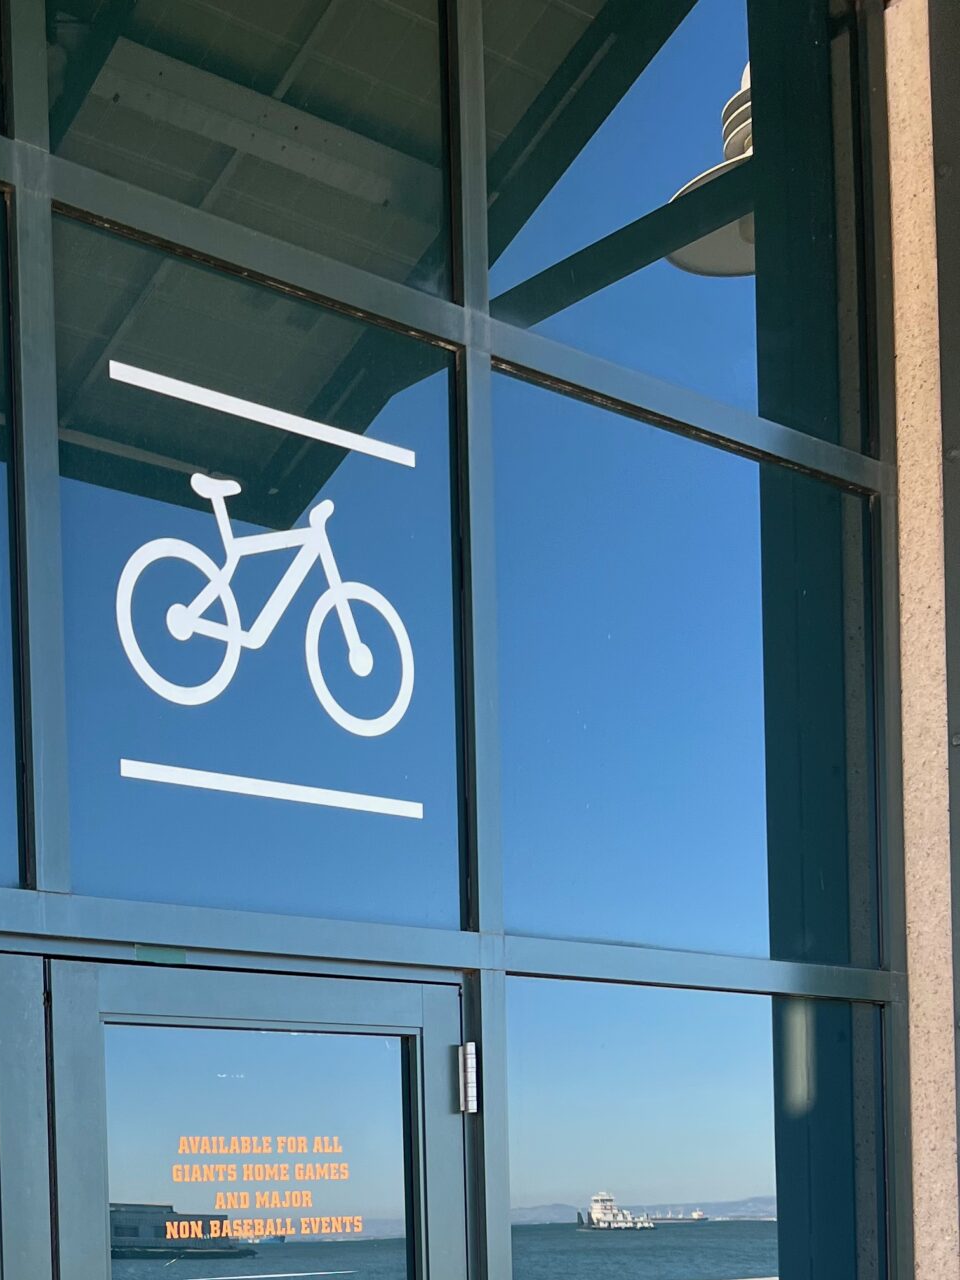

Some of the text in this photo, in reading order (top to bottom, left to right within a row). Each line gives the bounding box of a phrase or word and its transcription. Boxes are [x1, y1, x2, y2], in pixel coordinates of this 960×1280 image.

[178, 1136, 343, 1154] AVAILABLE FOR ALL
[172, 1163, 350, 1183] GIANTS HOME GAMES
[215, 1190, 313, 1210] AND MAJOR
[165, 1216, 363, 1239] NON BASEBALL EVENTS
